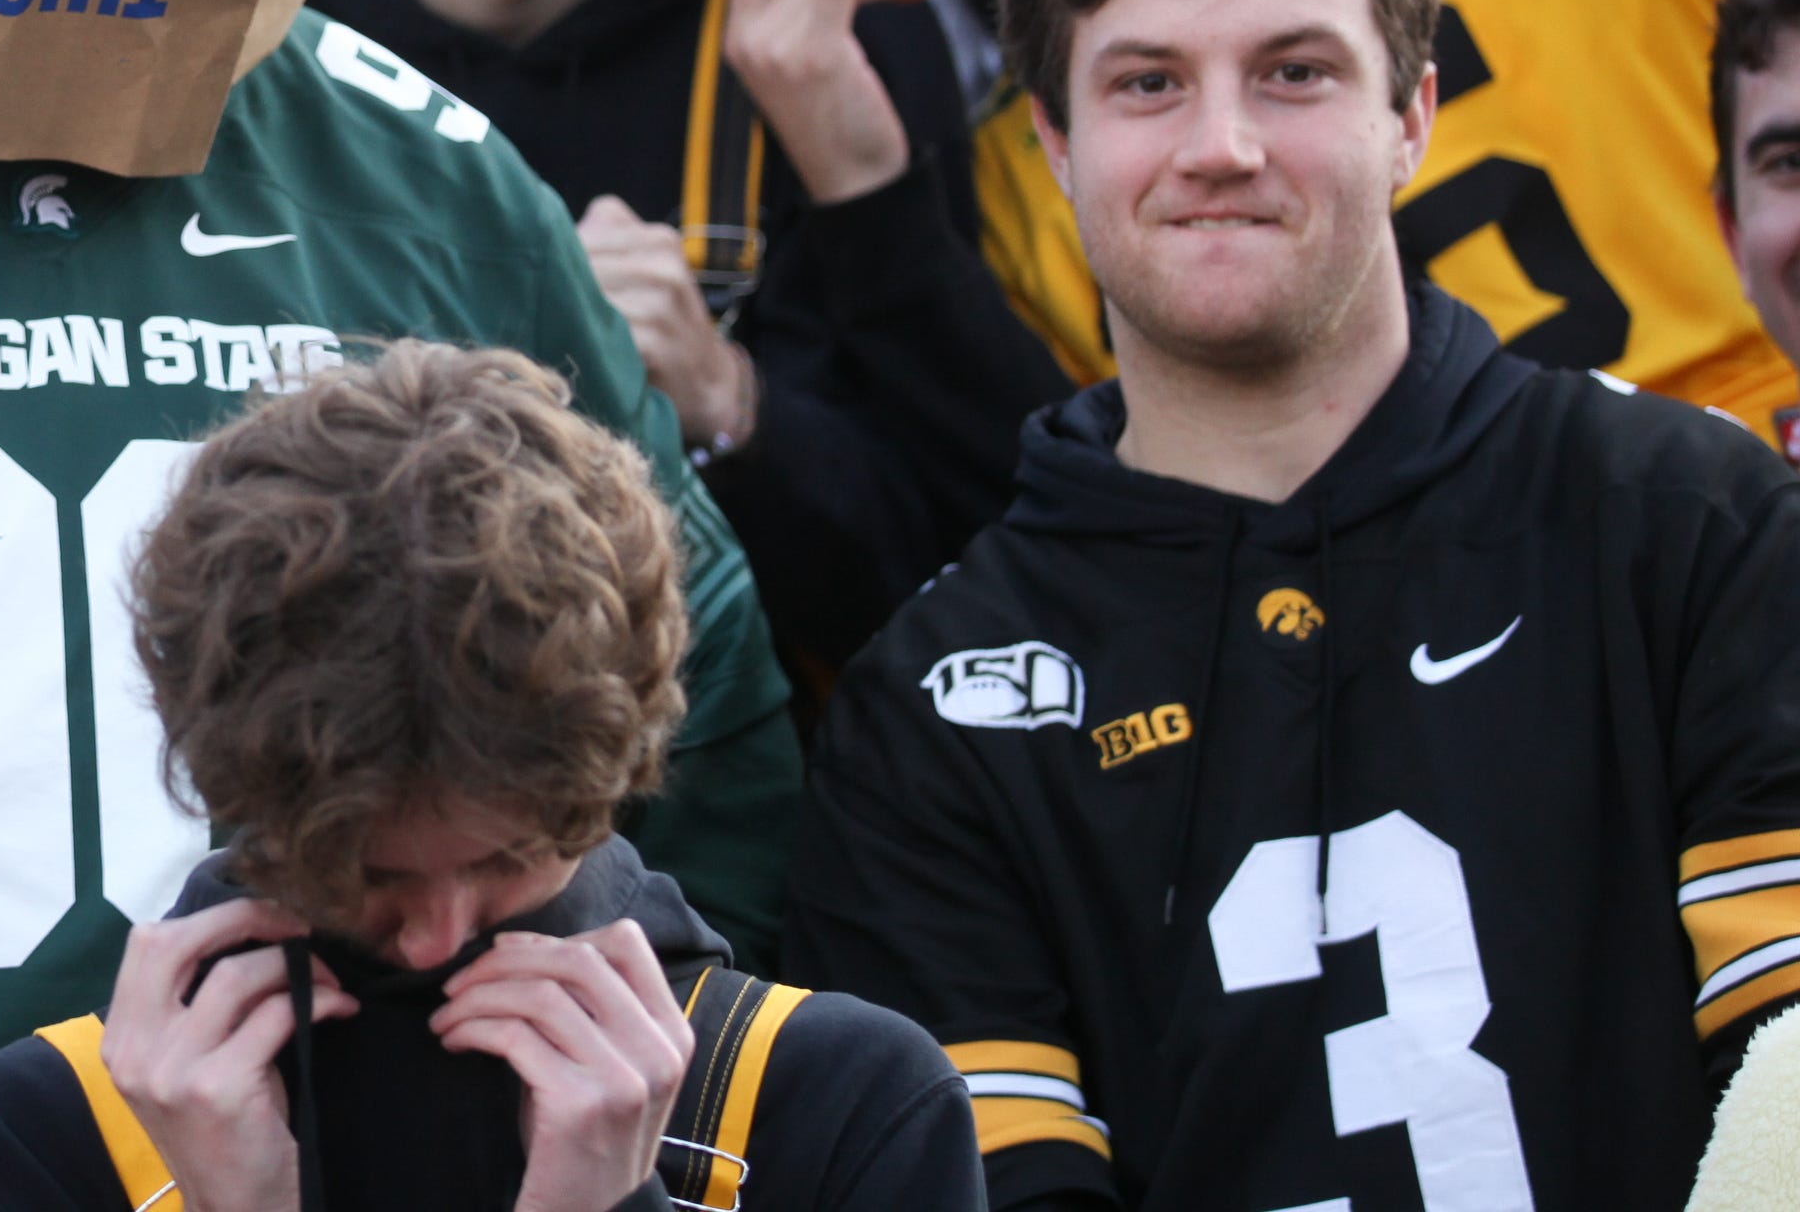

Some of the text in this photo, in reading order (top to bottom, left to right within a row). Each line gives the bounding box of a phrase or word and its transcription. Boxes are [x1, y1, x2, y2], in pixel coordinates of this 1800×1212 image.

[139, 315, 344, 395] STATE
[924, 643, 1083, 728] 150
[1207, 809, 1537, 1212] 3
